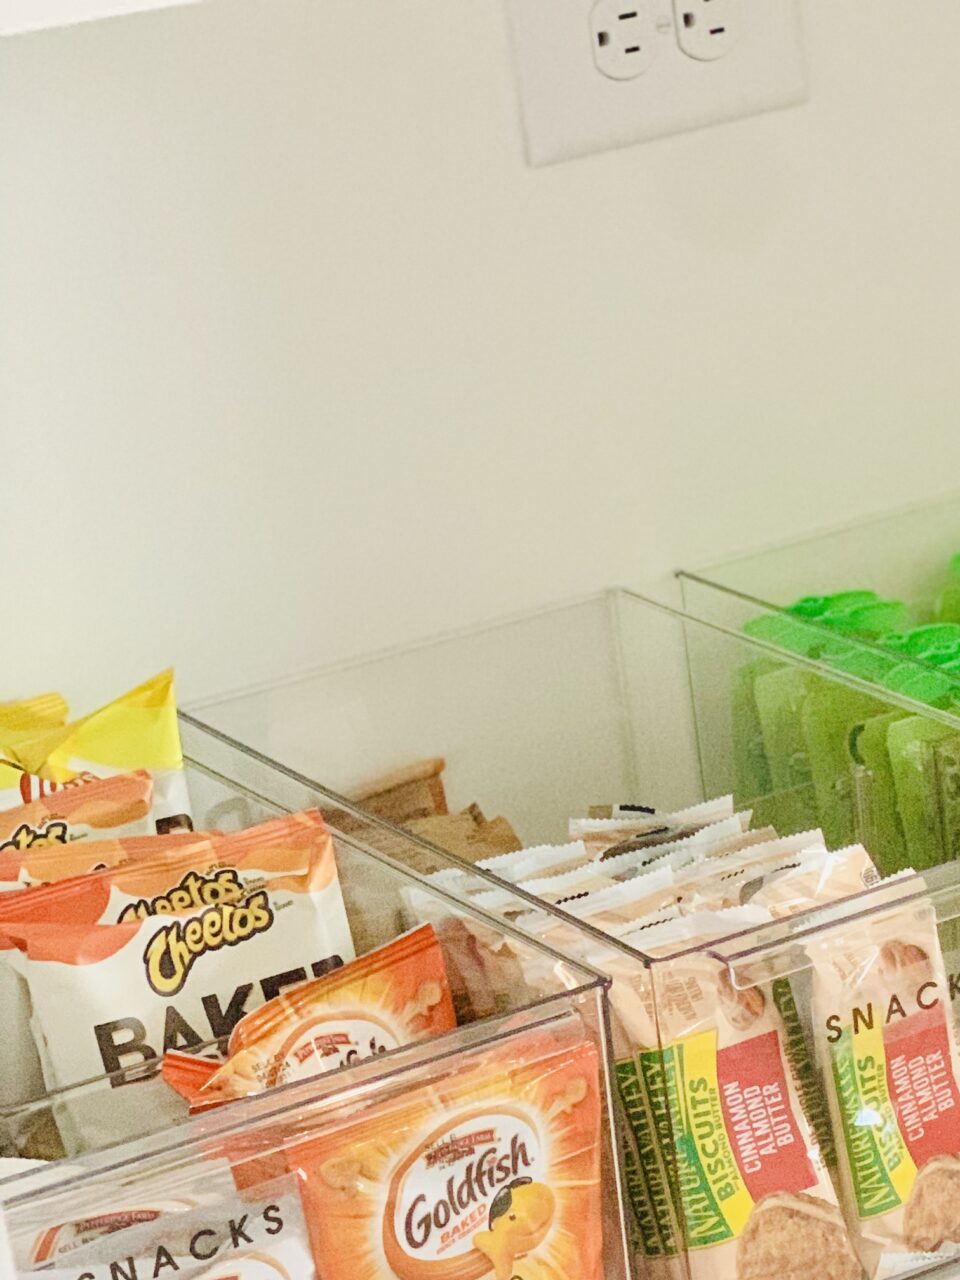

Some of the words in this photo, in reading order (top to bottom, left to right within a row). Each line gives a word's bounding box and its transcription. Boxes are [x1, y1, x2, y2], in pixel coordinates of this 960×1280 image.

[143, 891, 274, 997] Cheetos
[743, 1085, 778, 1156] ALMOND
[762, 1081, 795, 1147] BUTTER
[890, 1054, 925, 1142] CINNAMON
[908, 1055, 939, 1122] ALMOND
[926, 1050, 955, 1112] BUTTER
[689, 1077, 736, 1202] BISCUITS
[723, 1080, 762, 1174] CINNAMON
[404, 1133, 531, 1249] Goldfish
[440, 1203, 487, 1244] BAKED
